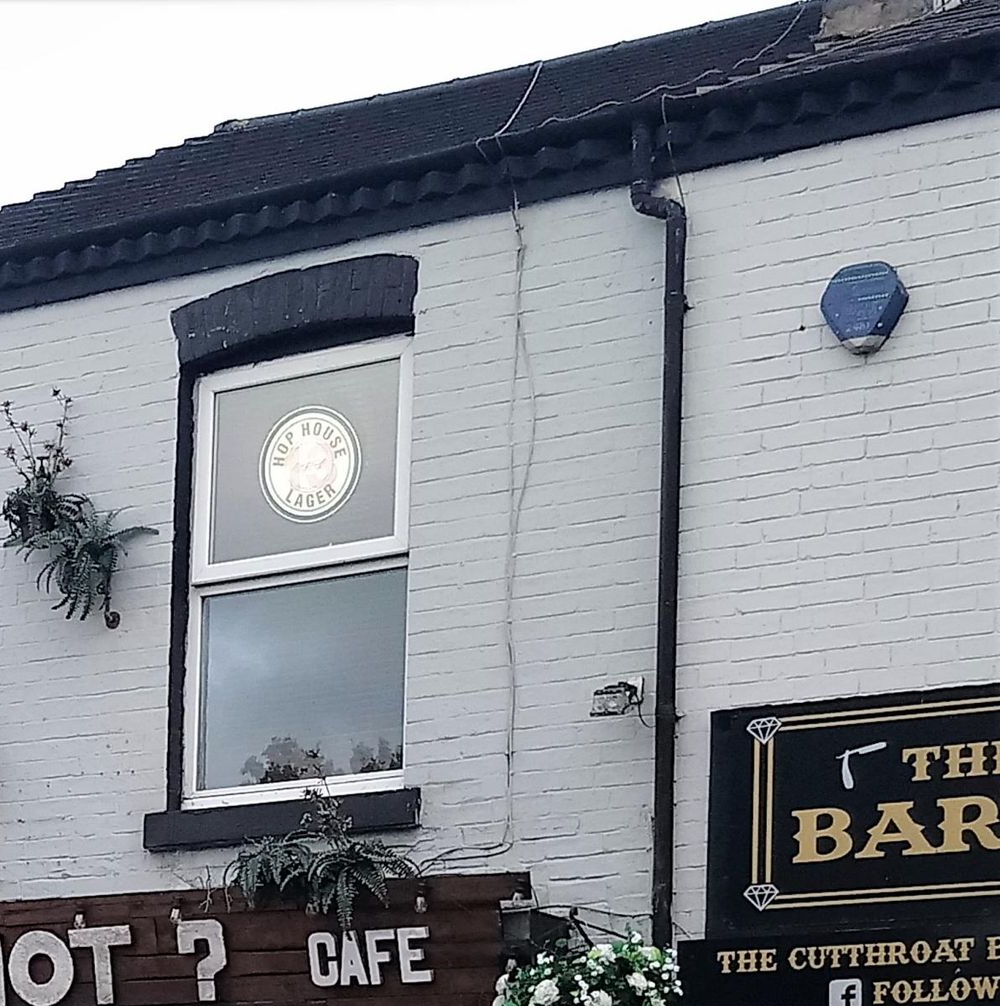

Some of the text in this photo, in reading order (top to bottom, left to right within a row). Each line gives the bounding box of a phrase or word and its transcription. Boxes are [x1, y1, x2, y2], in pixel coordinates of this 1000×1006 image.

[273, 422, 347, 467] HOP HOUSE
[285, 483, 336, 508] LAGER
[176, 918, 228, 1001] ?
[307, 925, 434, 988] CAFE
[717, 949, 778, 974] THE
[788, 937, 975, 970] CUTTHROAT
